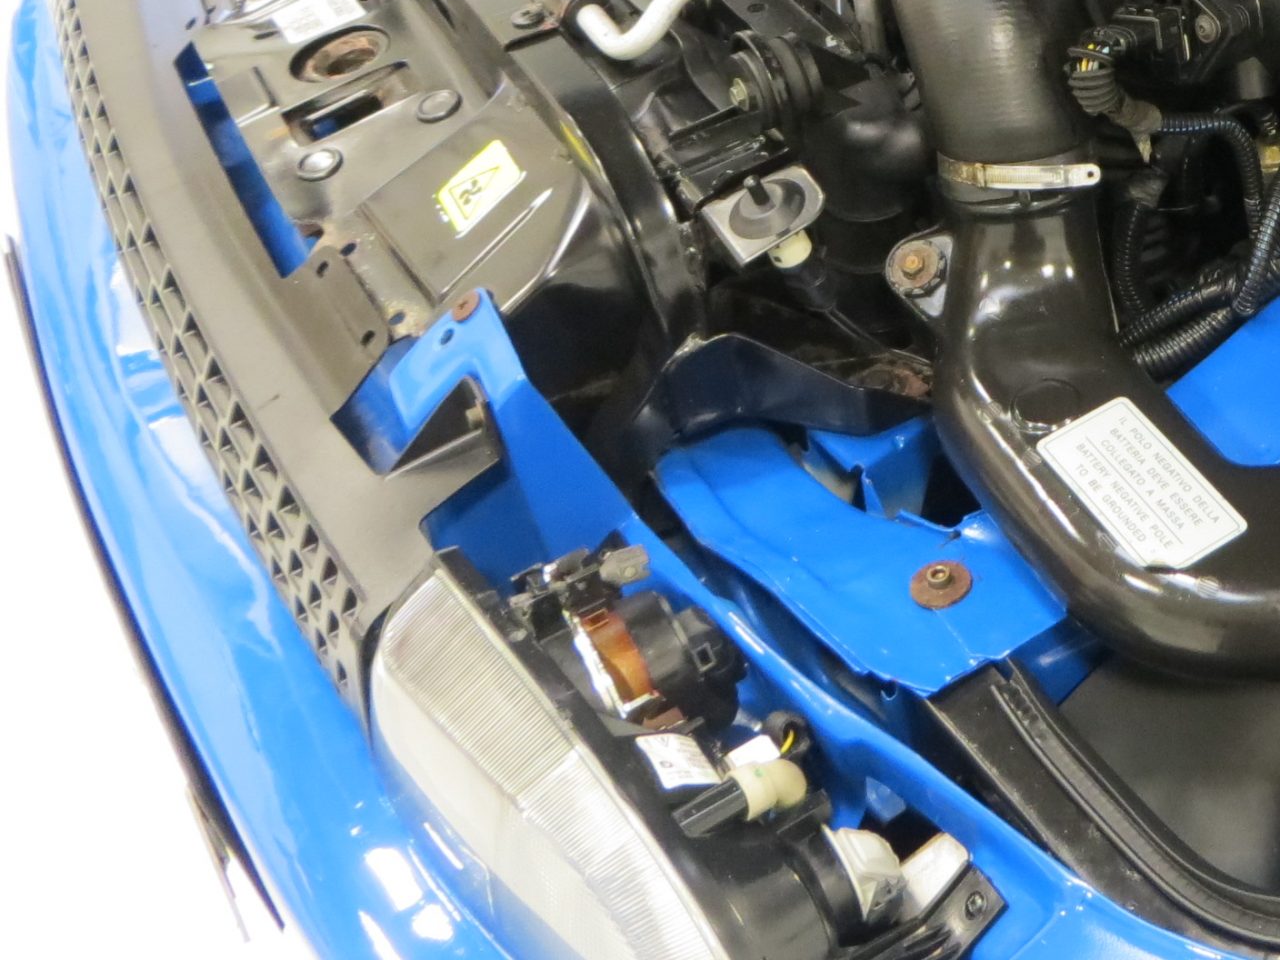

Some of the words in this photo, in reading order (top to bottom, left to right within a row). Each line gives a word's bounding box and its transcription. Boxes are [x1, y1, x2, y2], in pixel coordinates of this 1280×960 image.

[1075, 443, 1110, 478] BATTERY
[1111, 480, 1149, 522] NEGATIVE
[1149, 524, 1175, 550] POLE
[1075, 463, 1089, 477] TO
[1088, 479, 1102, 492] BE
[1101, 494, 1148, 543] GROUNDED
[1100, 439, 1147, 487] COLLEGATO
[1155, 498, 1185, 530] MASSA
[1109, 427, 1147, 467] BATTERIA
[1147, 467, 1170, 490] DEVE
[1169, 491, 1205, 527] ESSERE
[1130, 427, 1152, 451] POLO
[1153, 451, 1193, 493] NEGATIVO
[1192, 495, 1221, 524] DELLA
